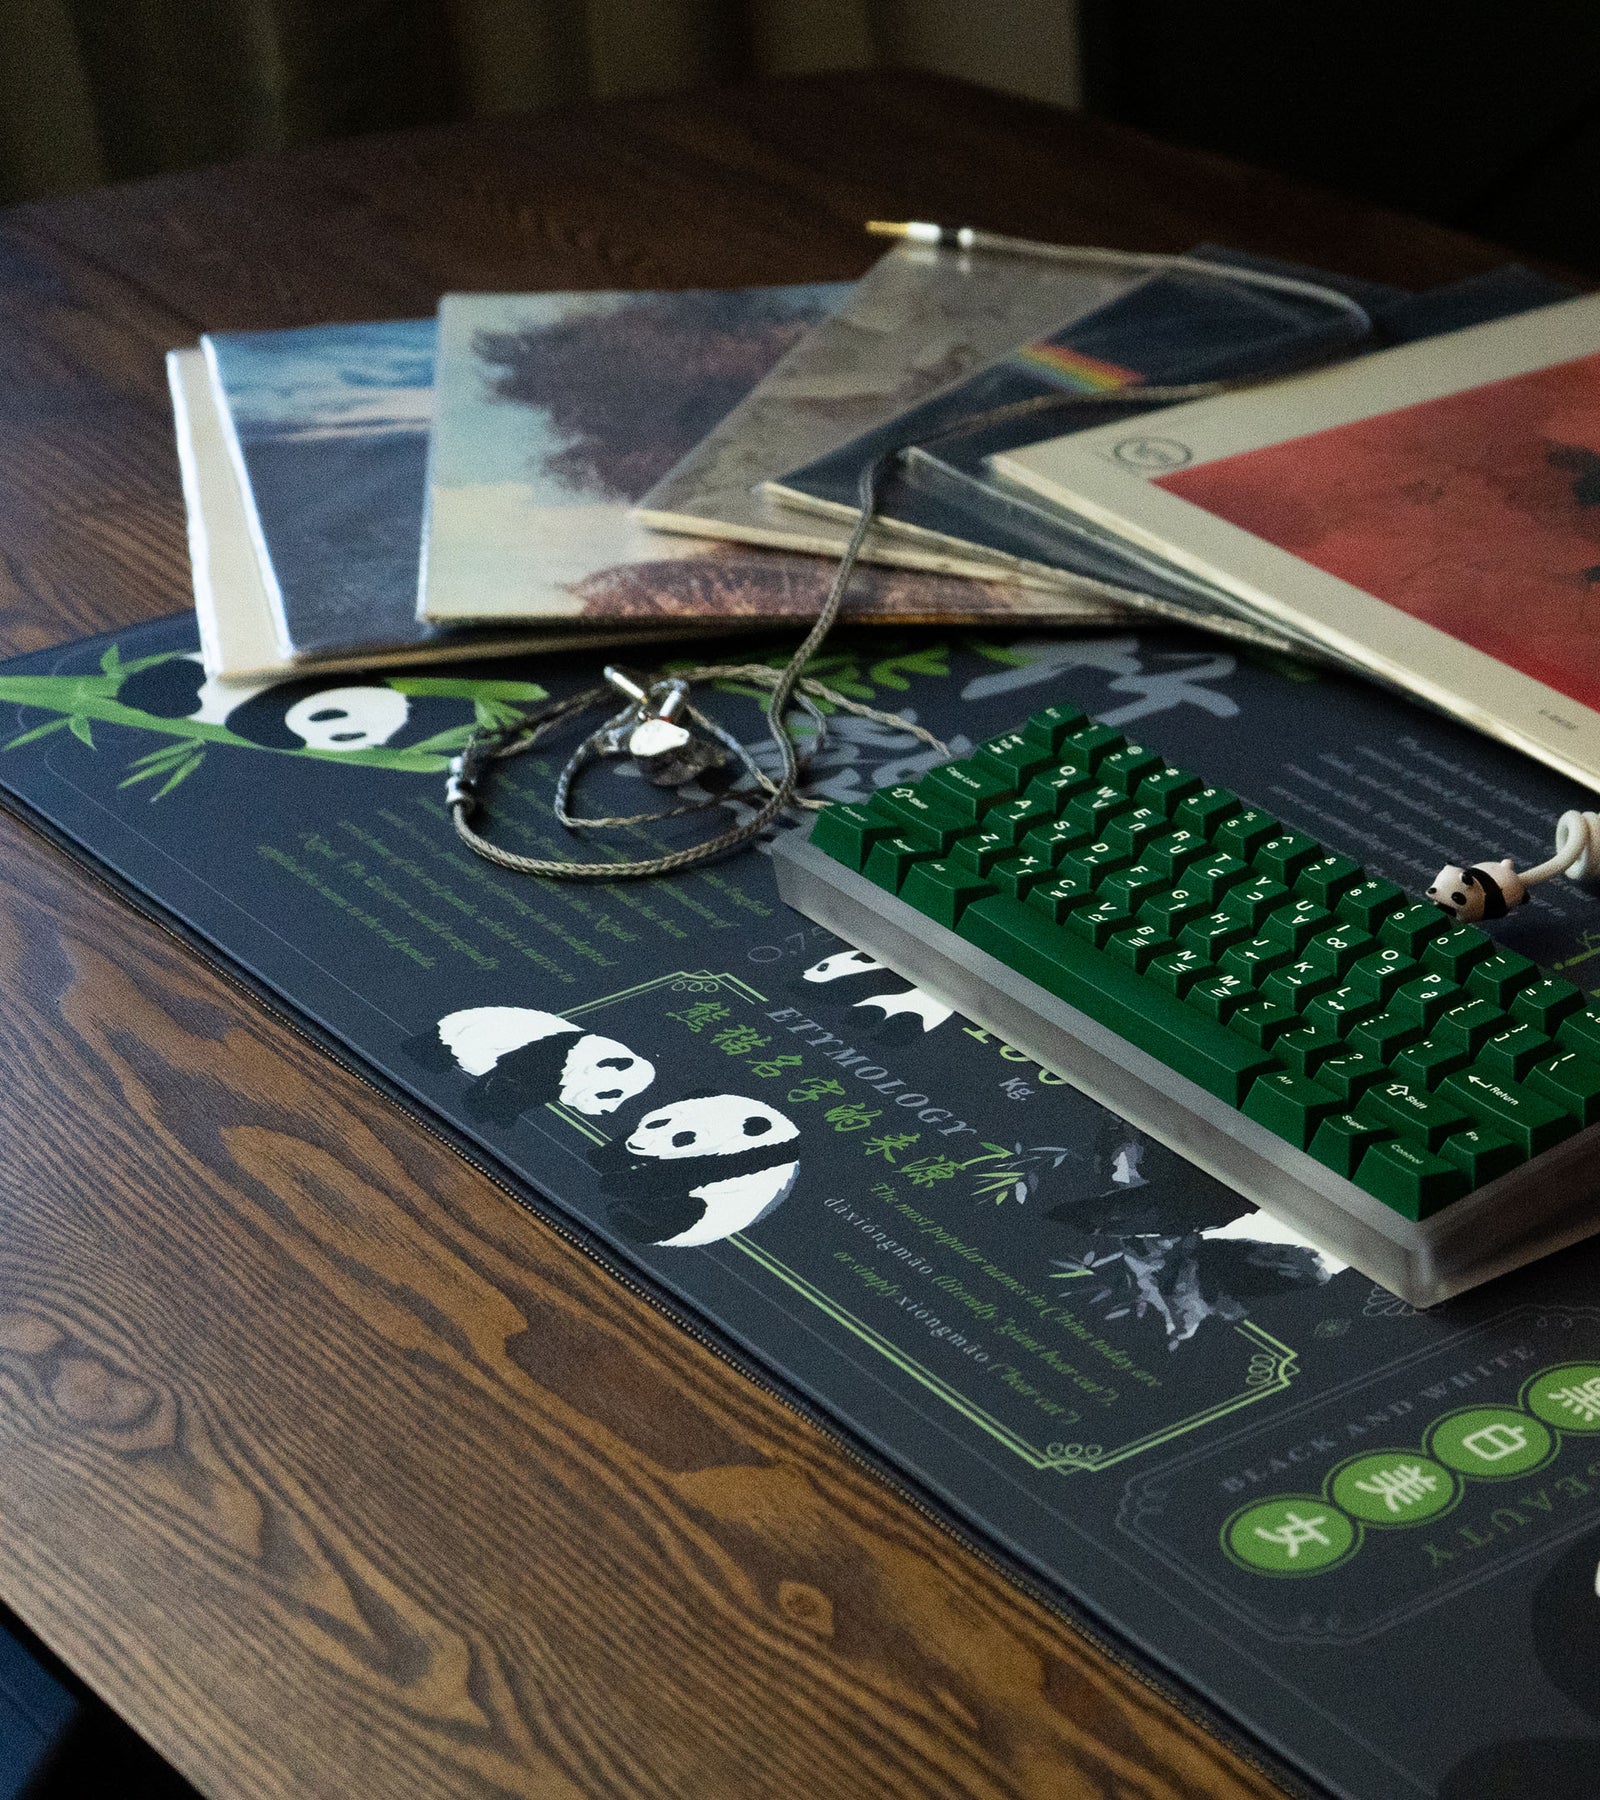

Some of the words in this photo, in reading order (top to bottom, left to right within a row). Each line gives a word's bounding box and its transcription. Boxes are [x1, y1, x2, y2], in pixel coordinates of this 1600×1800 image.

[1058, 765, 1077, 777] Q
[1096, 785, 1118, 799] W
[1014, 799, 1033, 810] A
[1132, 807, 1152, 820] E
[1053, 820, 1071, 831] S
[1226, 819, 1239, 828] 5
[980, 833, 1000, 843] Z
[1172, 829, 1191, 842] R
[1090, 842, 1110, 853] D
[1266, 841, 1279, 850] 6
[1019, 855, 1039, 866] X
[1214, 852, 1232, 863] T
[1129, 864, 1149, 874] F
[1058, 879, 1077, 889] C
[1255, 876, 1272, 886] Y
[1171, 889, 1190, 900] G
[1349, 888, 1363, 897] 8
[1098, 901, 1117, 911] V
[1295, 899, 1314, 912] U
[1210, 912, 1230, 924] H
[1392, 911, 1406, 921] 9
[1136, 925, 1156, 936] B
[1252, 939, 1270, 947] J
[1177, 949, 1197, 961] N
[1293, 961, 1314, 974] K
[1218, 974, 1241, 987] M
[1422, 973, 1442, 984] P
[1336, 986, 1351, 998] L
[764, 1005, 978, 1138] ETYMOLOGY
[1277, 1074, 1294, 1086] Alt
[999, 1075, 1036, 1104] Kg.
[1490, 1086, 1520, 1106] Return
[1403, 1095, 1429, 1111] Shift
[1341, 1113, 1369, 1131] Super
[1390, 1143, 1425, 1165] Control
[832, 1250, 857, 1264] or
[849, 1263, 902, 1298] simply
[869, 1182, 898, 1203] The
[895, 1202, 930, 1225] most
[920, 1225, 988, 1264] popular
[981, 1264, 1028, 1296] names
[1024, 1294, 1048, 1308] in
[1037, 1306, 1095, 1341] China
[1086, 1338, 1137, 1370] today
[1129, 1369, 1164, 1388] are
[1038, 1350, 1080, 1376] bear
[1220, 1435, 1337, 1494] BLACK
[1345, 1399, 1415, 1438] AND
[1420, 1344, 1535, 1400] WHITE
